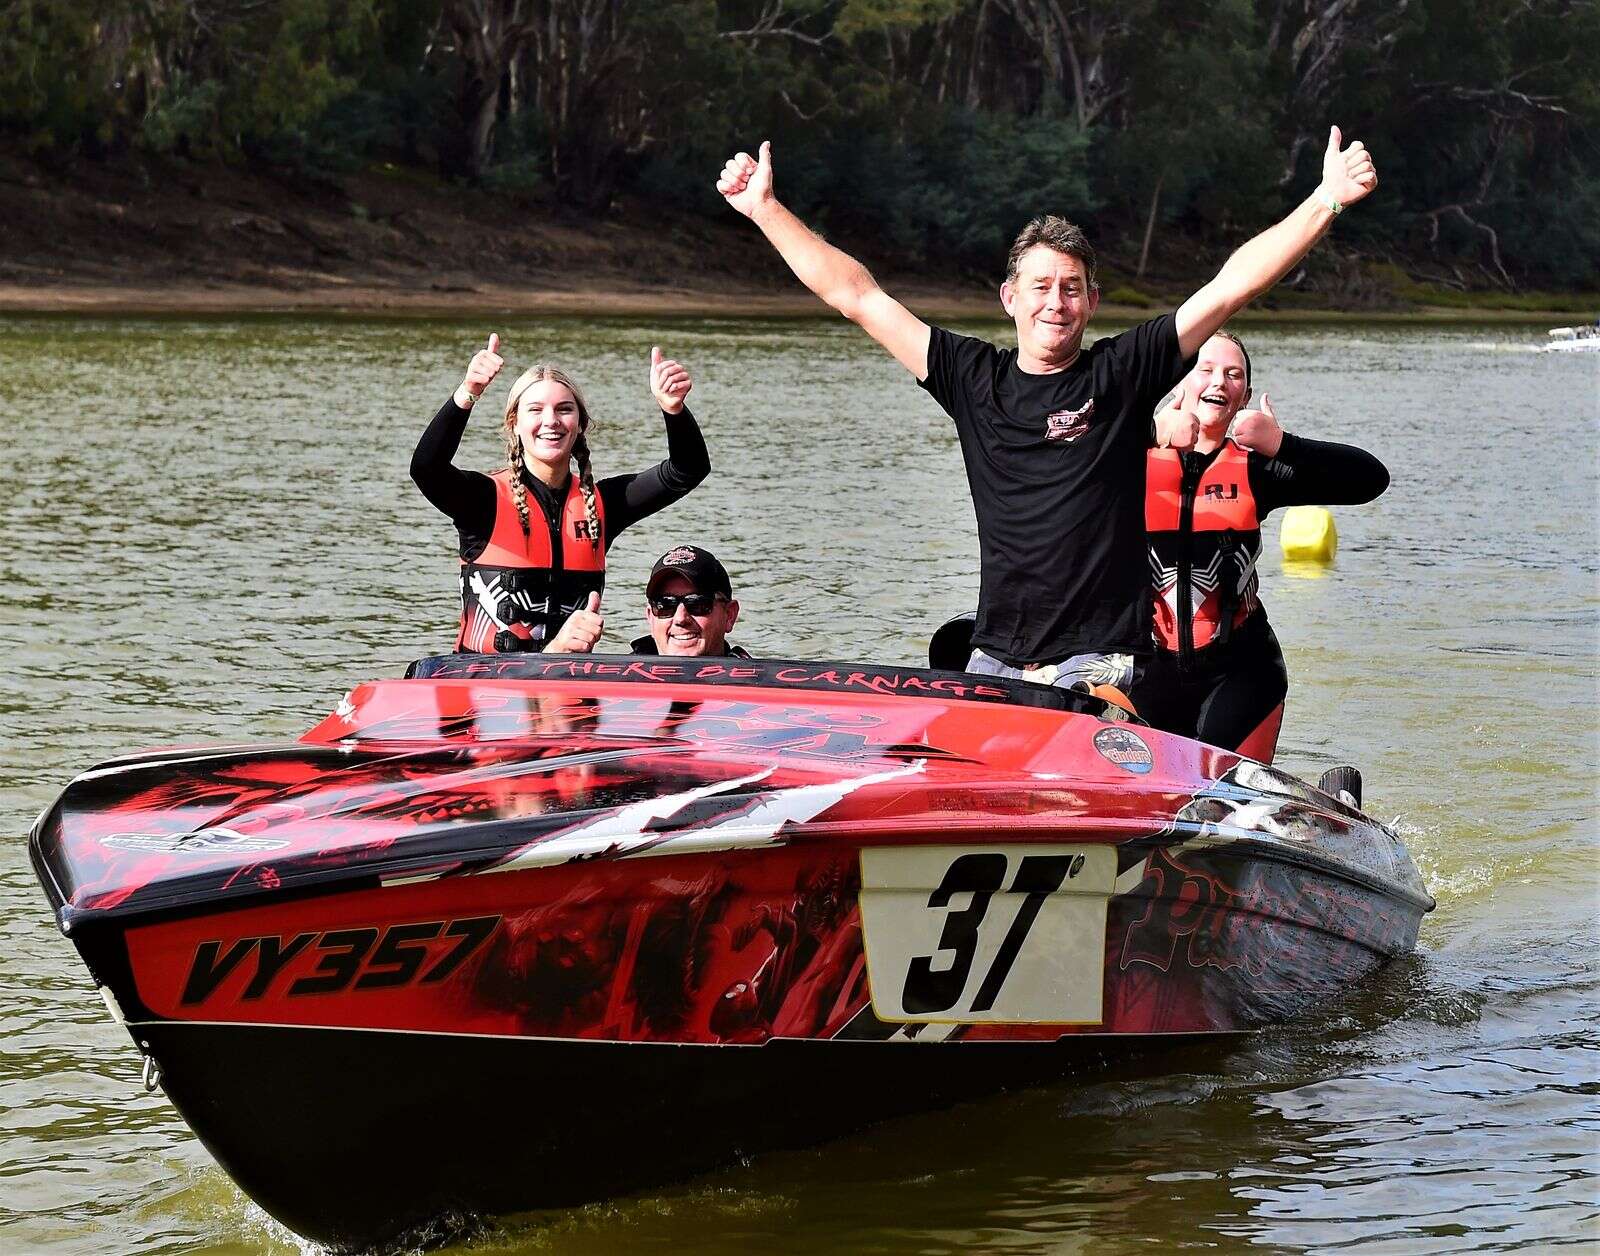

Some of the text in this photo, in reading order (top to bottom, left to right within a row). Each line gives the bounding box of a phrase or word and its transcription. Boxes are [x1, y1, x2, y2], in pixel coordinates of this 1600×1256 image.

[430, 660, 1008, 697] LET THERE BE CARNAGE
[180, 914, 502, 1007] VY357
[902, 853, 1073, 1014] 37
